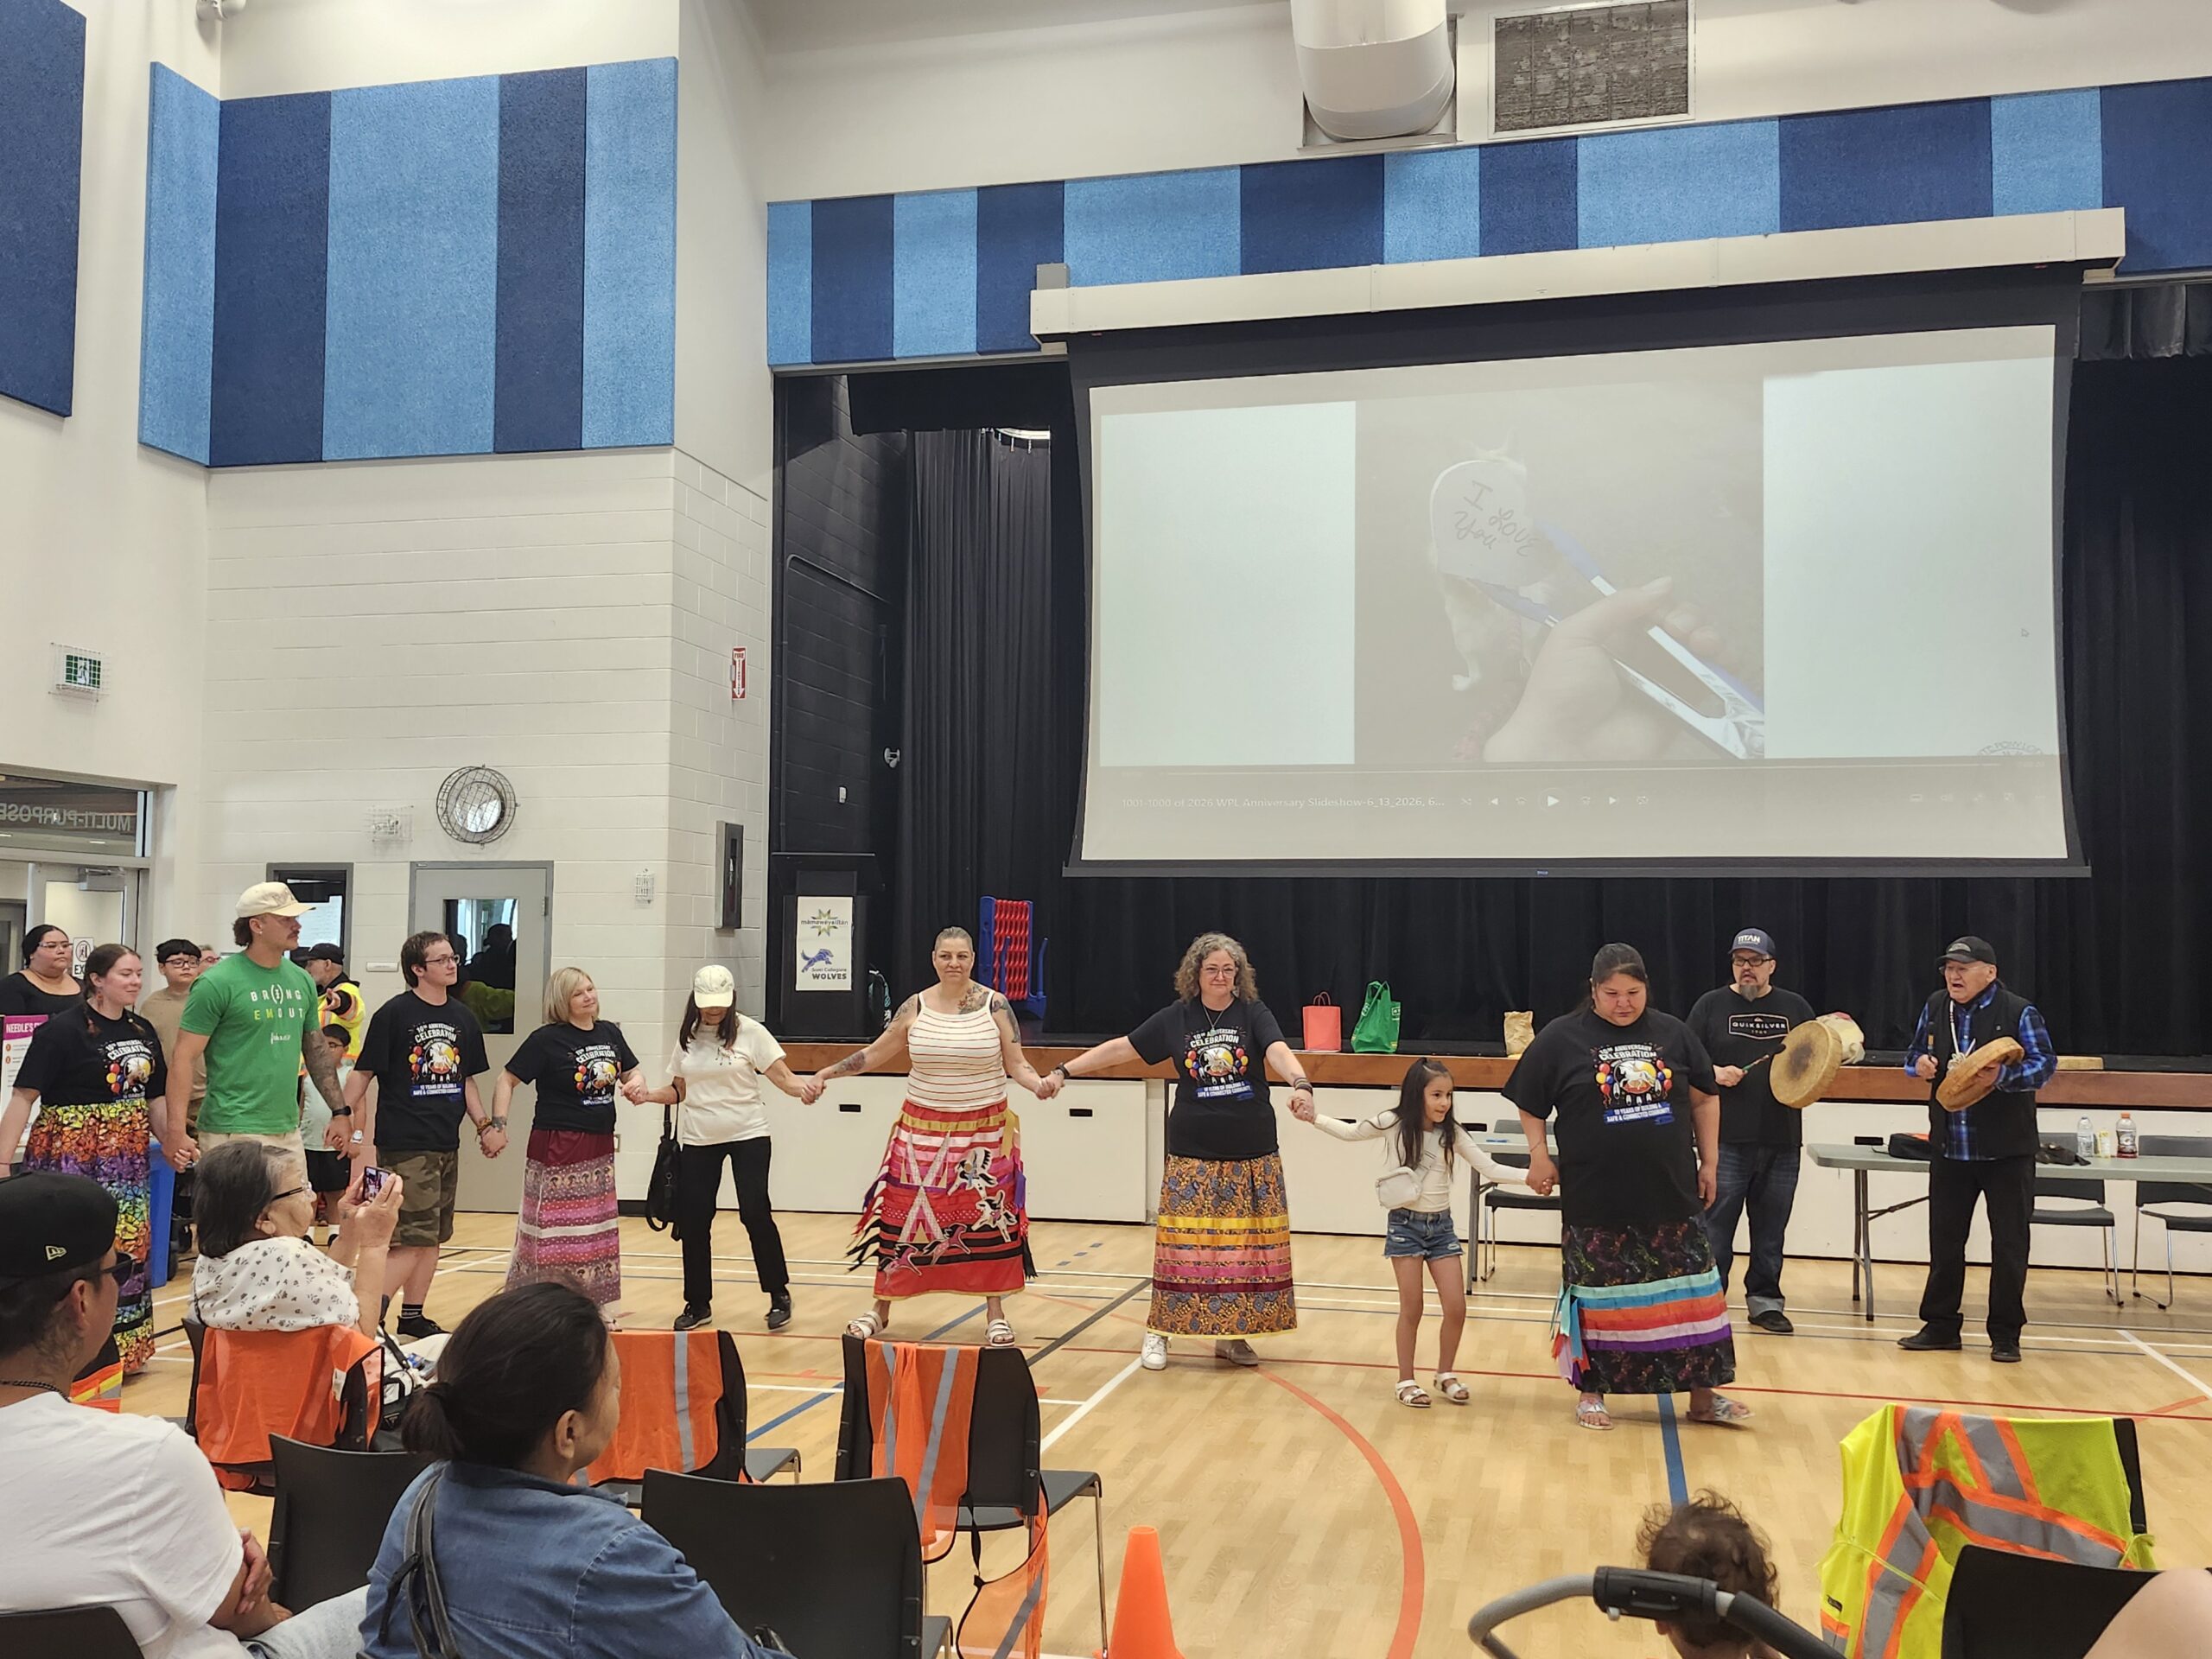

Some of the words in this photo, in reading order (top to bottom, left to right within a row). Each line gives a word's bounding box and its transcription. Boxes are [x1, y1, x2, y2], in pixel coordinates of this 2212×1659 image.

[1173, 798, 1185, 808] of
[1188, 798, 1213, 808] 2026
[1216, 798, 1239, 807] WPL
[1243, 797, 1306, 810] Anniversary
[1190, 1035, 1239, 1047] CELEBRATION
